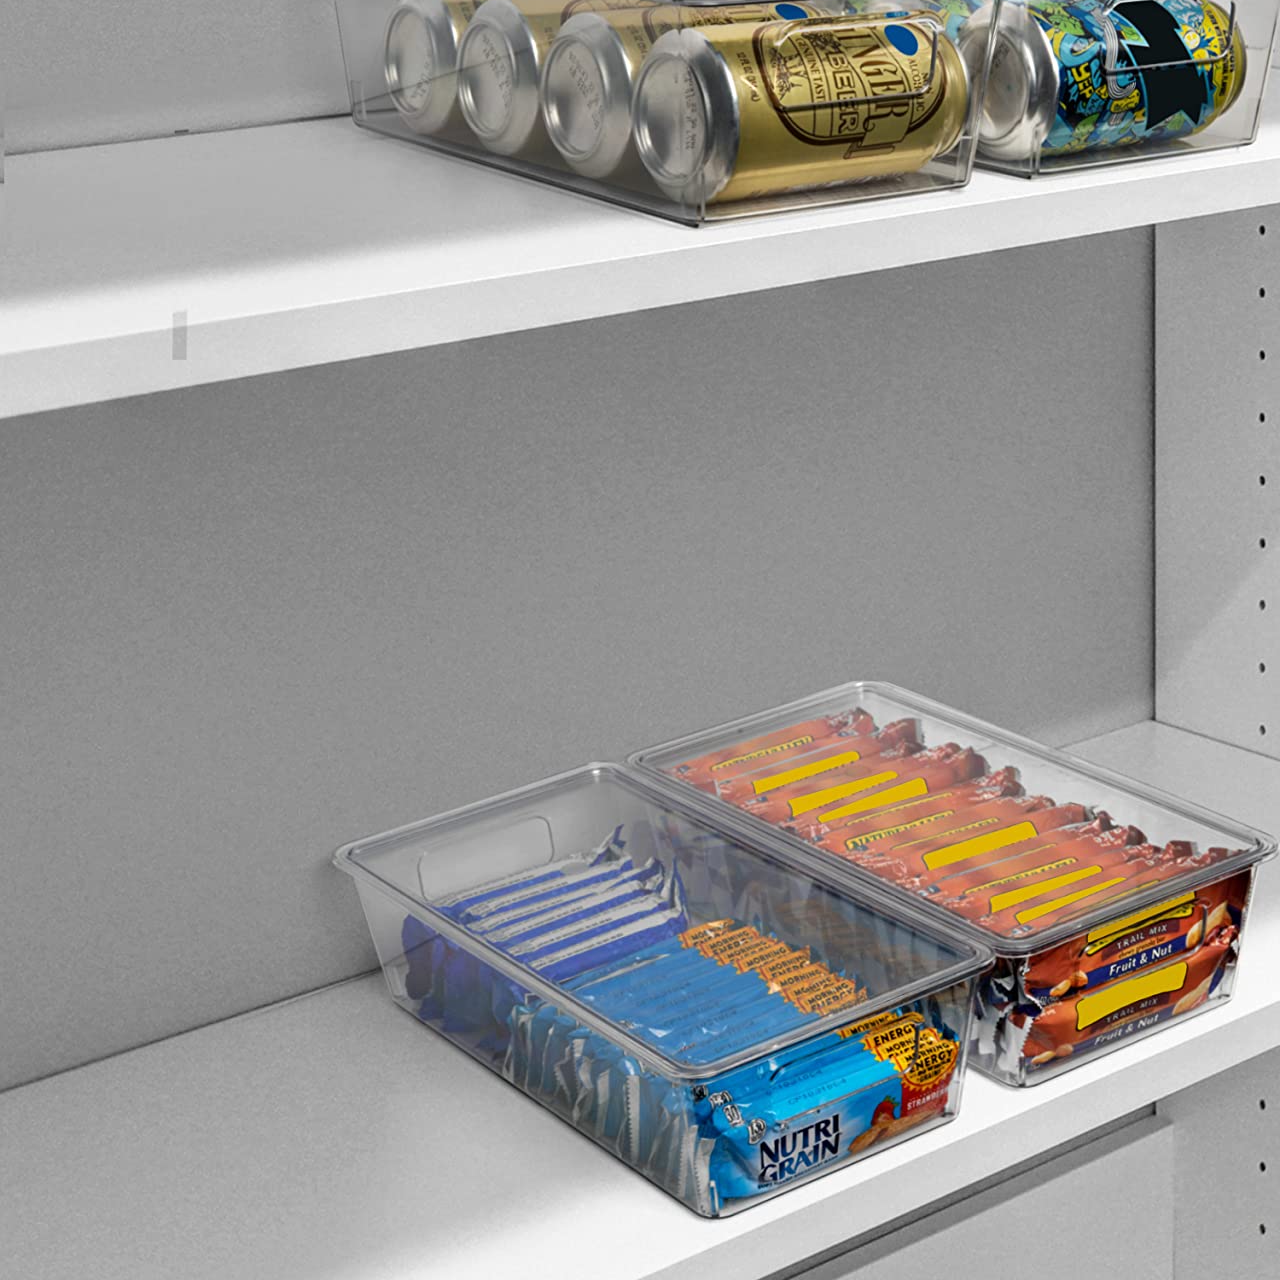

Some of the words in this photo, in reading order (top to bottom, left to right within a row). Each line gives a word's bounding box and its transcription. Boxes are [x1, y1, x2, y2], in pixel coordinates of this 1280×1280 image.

[826, 50, 860, 134] BEER
[832, 28, 910, 132] INGER
[908, 59, 926, 112] ALCOHLIC
[1117, 933, 1145, 949] TRAIL
[1149, 924, 1168, 935] MIX
[1109, 958, 1137, 977] Fruit
[1140, 952, 1148, 965] &
[1152, 944, 1172, 960] Nut
[1094, 1028, 1122, 1046] Fruit
[1125, 1023, 1133, 1034] &
[1137, 1014, 1159, 1029] Nut
[1106, 1007, 1134, 1023] TRAIL
[1140, 998, 1158, 1009] MIX
[905, 1043, 949, 1062] MRNING
[758, 1132, 842, 1183] GRAIN
[760, 1114, 840, 1170] NUTRI
